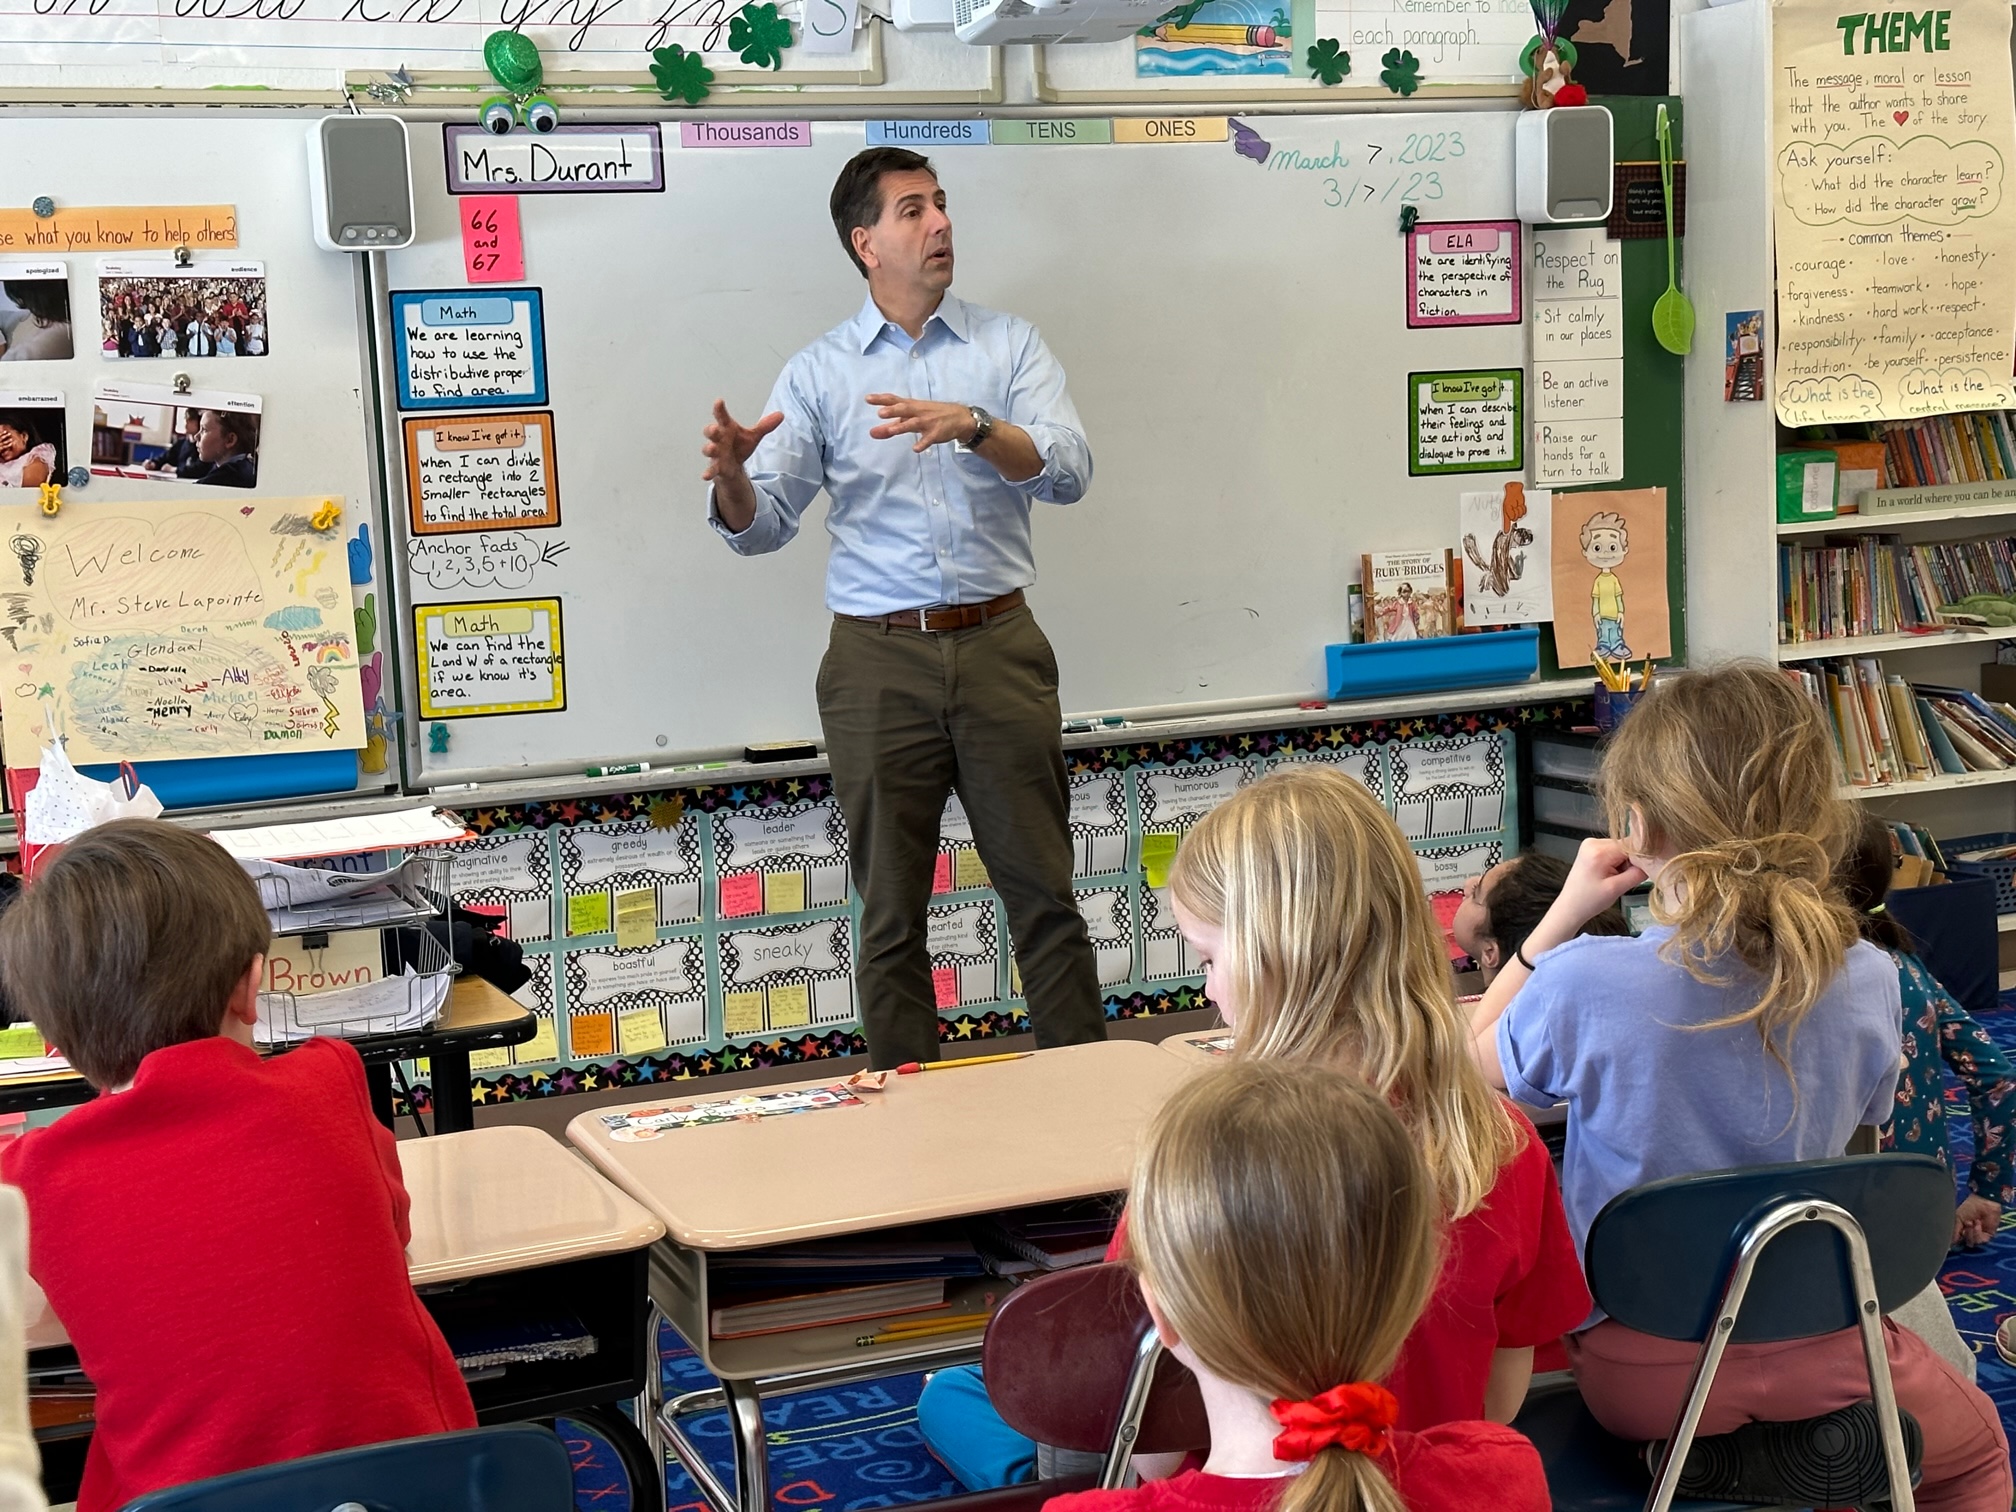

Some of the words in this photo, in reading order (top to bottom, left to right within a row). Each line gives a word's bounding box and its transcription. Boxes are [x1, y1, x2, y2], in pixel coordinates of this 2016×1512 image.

[1353, 19, 1394, 45] each
[1403, 18, 1480, 63] paragraph.
[1837, 10, 1951, 55] THEME
[1784, 66, 1809, 87] The
[1874, 67, 1904, 84] moral
[1934, 67, 1971, 82] lesson
[1789, 97, 1813, 114] that
[1822, 94, 1840, 112] the
[1849, 94, 1880, 110] author
[1886, 95, 1915, 108] wants
[1937, 91, 1967, 105] share
[696, 122, 799, 143] Thousands
[883, 121, 972, 140] Hundreds
[1026, 122, 1076, 139] TENS
[1145, 120, 1196, 138] ONES
[1791, 119, 1816, 134] with
[1824, 123, 1850, 140] you.
[1860, 112, 1886, 128] The
[1931, 111, 1948, 124] the
[464, 148, 523, 184] Mrs.
[531, 138, 632, 182] Durant
[1268, 140, 1349, 170] March
[1787, 148, 1817, 167] Ask
[1825, 144, 1892, 174] yourself:
[1812, 177, 1841, 190] What
[1849, 174, 1866, 189] did
[1874, 173, 1893, 188] the
[1901, 170, 1947, 186] character
[1956, 161, 1994, 180] learn?
[1814, 203, 1836, 214] How
[1845, 199, 1862, 213] did
[1870, 197, 1889, 211] the
[1895, 194, 1944, 208] character
[1952, 187, 1989, 215] grow?
[471, 210, 498, 232] 66
[26, 222, 60, 244] what
[65, 232, 91, 251] you
[98, 220, 133, 243] know
[165, 219, 190, 247] help
[197, 216, 236, 242] others?
[474, 236, 498, 248] and
[1447, 234, 1473, 248] ELA
[1849, 233, 1893, 246] common
[1900, 224, 1943, 242] themes
[472, 254, 500, 271] 67
[1418, 256, 1432, 265] We
[1462, 253, 1512, 270] identifying
[1534, 240, 1596, 274] Respect
[1419, 271, 1435, 281] the
[1442, 271, 1496, 284] perspective
[1546, 275, 1565, 289] the
[1578, 269, 1605, 297] Rug
[1418, 286, 1471, 297] characters
[440, 306, 477, 319] Math
[1419, 302, 1459, 316] fiction.
[1544, 307, 1561, 324] Sit
[1569, 304, 1605, 327] calmly
[407, 327, 427, 341] We
[434, 332, 458, 340] are
[466, 329, 523, 349] learning
[1561, 331, 1573, 341] our
[1581, 326, 1612, 346] places
[410, 345, 435, 360] how
[463, 350, 488, 360] use
[494, 347, 517, 360] the
[411, 364, 489, 379] distributive
[1543, 371, 1558, 389] Be
[1579, 371, 1608, 387] active
[433, 384, 462, 397] find
[471, 387, 510, 396] area.
[1443, 382, 1462, 392] know
[1482, 381, 1496, 398] got
[1790, 387, 1831, 403] What
[1853, 382, 1875, 399] the
[1907, 380, 1943, 396] What
[1964, 378, 1984, 392] the
[227, 400, 255, 408] attention
[1420, 403, 1443, 415] when
[1482, 401, 1519, 412] describe
[1543, 394, 1584, 408] listener
[1421, 418, 1445, 429] their
[1450, 416, 1484, 434] feelings
[1489, 415, 1506, 426] and
[448, 431, 469, 442] know
[472, 428, 491, 441] I've
[1442, 431, 1481, 442] actions
[1487, 429, 1504, 441] and
[1543, 426, 1573, 444] Raise
[1581, 433, 1598, 442] our
[421, 457, 451, 468] when
[477, 457, 499, 465] can
[507, 449, 541, 467] divide
[1419, 447, 1453, 464] dialogue
[1468, 448, 1490, 461] prove
[1543, 447, 1573, 460] hands
[1579, 445, 1593, 460] for
[439, 470, 492, 490] rectangle
[502, 467, 521, 481] into
[1542, 465, 1564, 477] turn
[421, 488, 470, 500] smaller
[481, 485, 545, 505] rectangles
[1897, 494, 1922, 505] world
[1924, 492, 1952, 504] where
[1954, 494, 1970, 507] you
[1973, 492, 1989, 502] can
[440, 505, 465, 522] find
[469, 507, 489, 520] the
[492, 505, 516, 518] total
[521, 507, 548, 517] area.
[415, 539, 471, 556] Anchor
[66, 543, 205, 578] Welcome
[1375, 567, 1400, 578] RUBY
[1402, 563, 1444, 575] BRIDGES
[69, 597, 106, 621] Mr.
[117, 595, 170, 615] Steve
[179, 590, 263, 615] Lapointe
[454, 614, 499, 633] Math
[430, 639, 448, 652] We
[456, 641, 480, 651] can
[486, 636, 513, 650] find
[518, 635, 545, 650] the
[92, 659, 129, 670] Leah
[442, 654, 462, 667] and
[512, 651, 563, 674] rectangle
[480, 670, 509, 681] know
[518, 668, 536, 681] it's
[431, 687, 471, 698] area.
[153, 705, 192, 718] Henry
[264, 730, 302, 740] Damon
[1421, 754, 1471, 767] competitive
[1174, 781, 1219, 793] humorous
[763, 822, 795, 836] leader
[611, 838, 648, 853] greedy
[1434, 862, 1458, 872] bossy
[753, 939, 813, 965] sneaky
[613, 958, 656, 972] boastful
[269, 956, 372, 993] Brown
